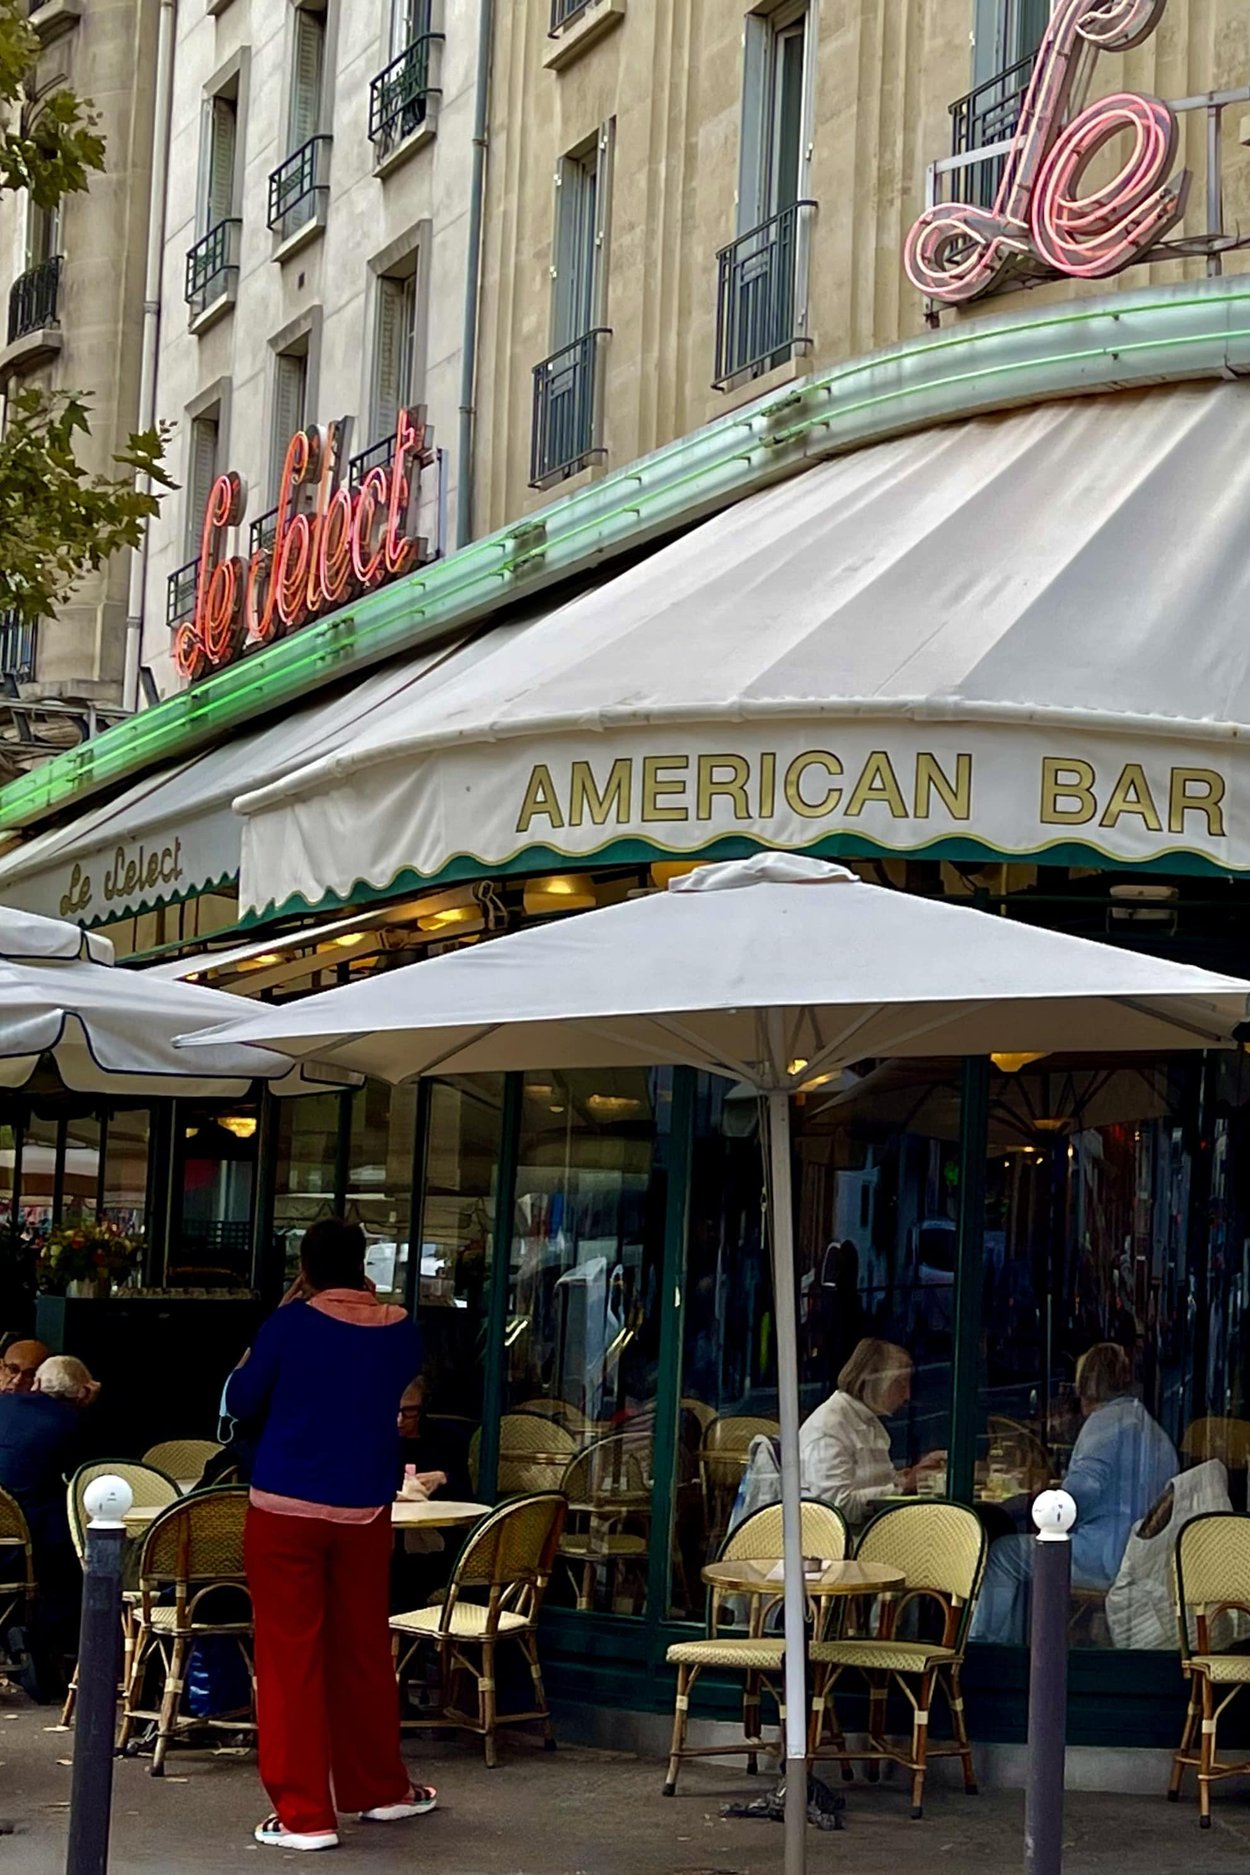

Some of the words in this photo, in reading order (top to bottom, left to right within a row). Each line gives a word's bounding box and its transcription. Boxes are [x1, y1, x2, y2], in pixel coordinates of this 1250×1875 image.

[904, 0, 1193, 301] Le
[175, 471, 247, 680] Le
[247, 404, 434, 641] Select
[60, 863, 92, 917] Le
[104, 836, 183, 900] Select
[514, 749, 974, 833] AMERICAN
[1038, 755, 1228, 837] BAR
